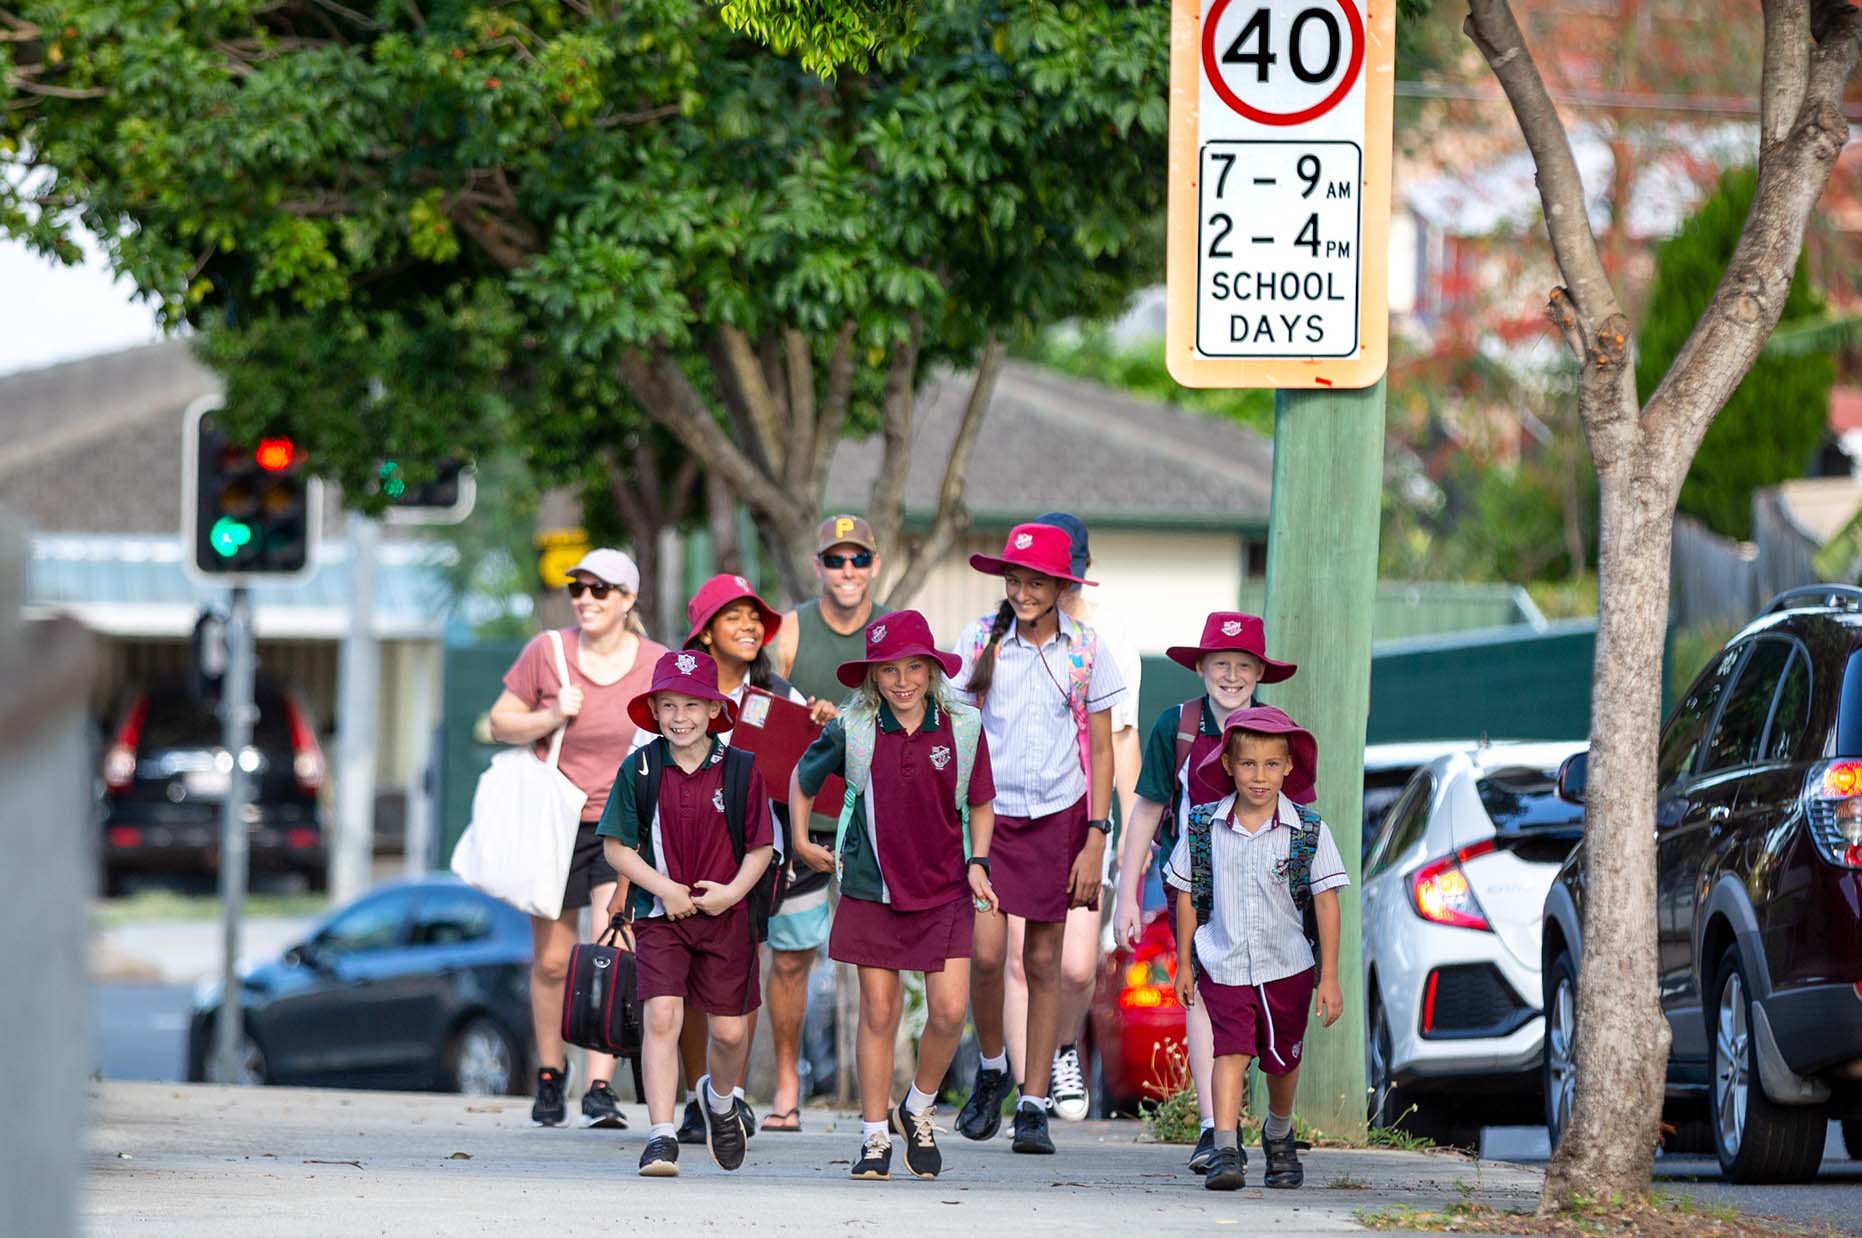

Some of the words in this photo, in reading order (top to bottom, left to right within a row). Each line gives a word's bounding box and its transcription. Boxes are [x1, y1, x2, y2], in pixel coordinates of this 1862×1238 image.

[1221, 7, 1342, 84] 40
[1210, 153, 1236, 199] 7
[1326, 181, 1351, 199] AM
[1208, 212, 1233, 259] 2
[1326, 240, 1350, 258] PM
[1211, 271, 1345, 301] SCHOOL
[1230, 314, 1324, 343] DAYS
[835, 517, 855, 539] P
